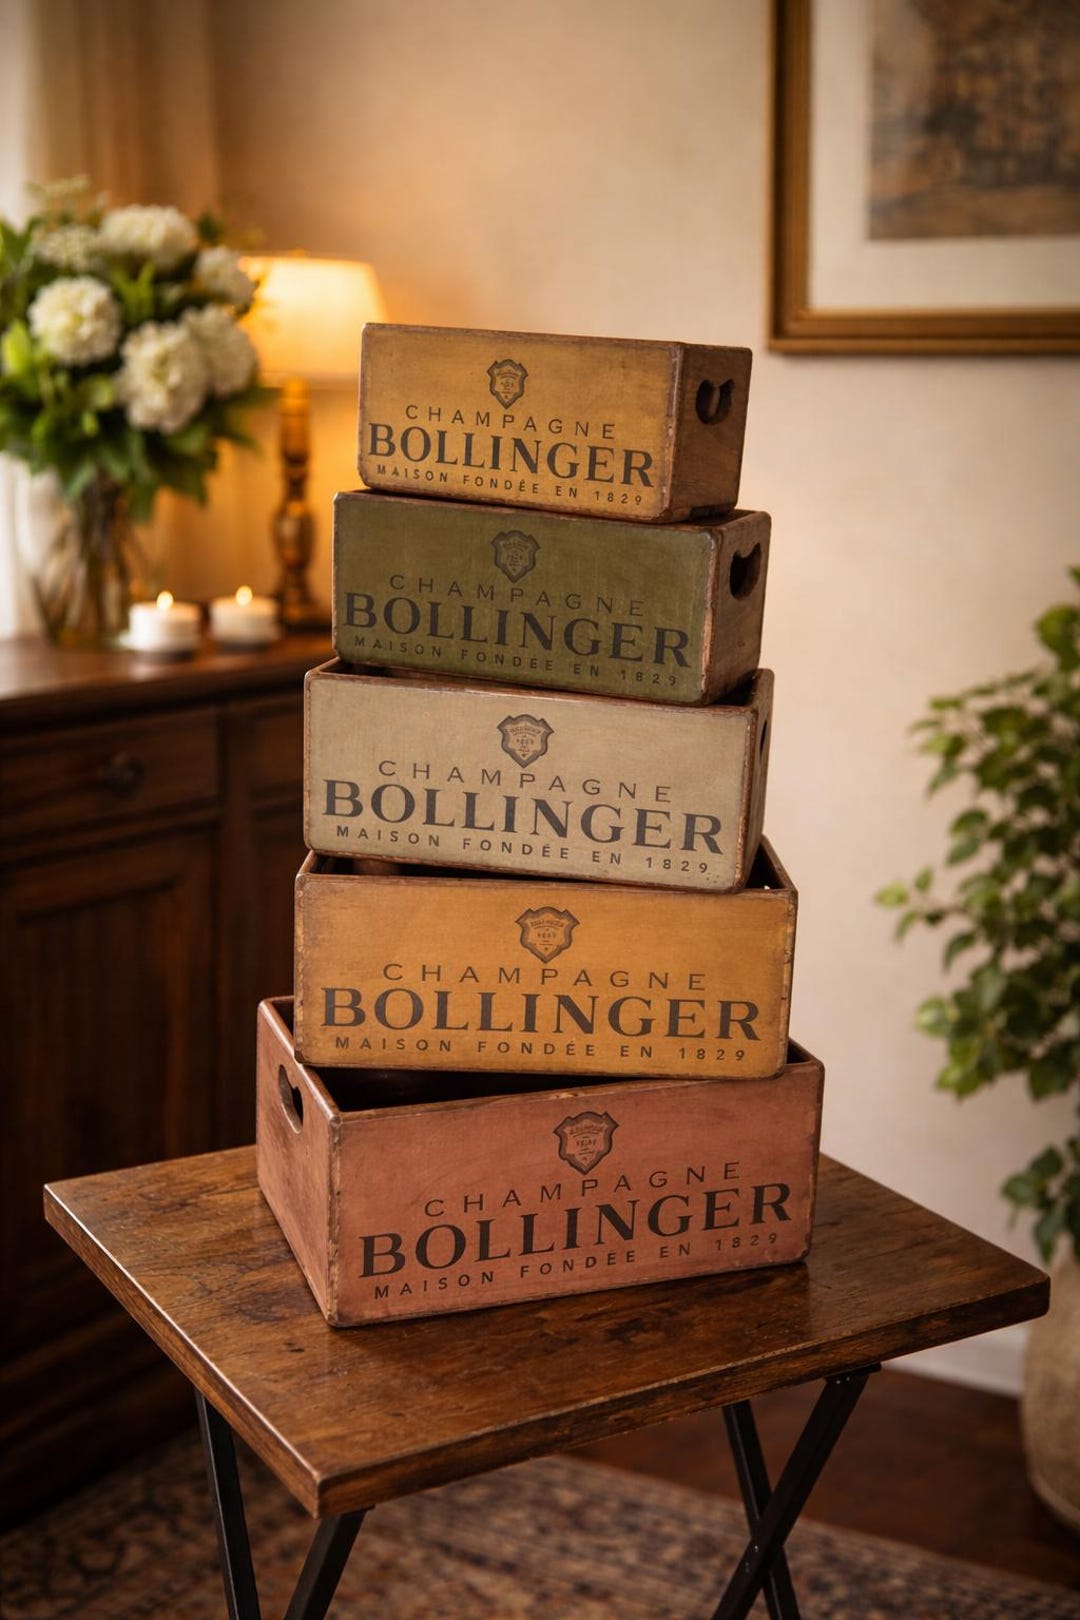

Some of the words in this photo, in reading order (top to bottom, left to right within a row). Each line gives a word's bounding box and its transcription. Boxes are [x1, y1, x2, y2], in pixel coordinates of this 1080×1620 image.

[405, 404, 616, 439] CHAMPAGNE
[368, 422, 654, 488] BOLLINGER
[377, 464, 448, 483] MAISON
[556, 485, 578, 499] EN
[595, 491, 642, 506] 1829
[389, 574, 645, 616] CHAMPAGNE
[343, 591, 692, 668] BOLLINGER
[355, 635, 442, 657] MAISON
[573, 663, 599, 677] EN
[621, 669, 677, 686] 1829
[378, 760, 672, 803] CHAMPAGNE
[322, 779, 724, 856] BOLLINGER
[337, 825, 440, 847] MAISON
[463, 838, 569, 859] FONDÉE
[592, 851, 622, 865] EN
[645, 857, 708, 874] 1829
[382, 963, 706, 991] CHAMPAGNE
[320, 986, 761, 1041] BOLLINGER
[335, 1036, 452, 1052] MAISON
[478, 1038, 596, 1057] FONDÉE
[620, 1045, 653, 1059] EN
[678, 1047, 746, 1062] 1829
[424, 1161, 741, 1218] CHAMPAGNE
[358, 1182, 792, 1279] BOLLINGER
[374, 1270, 495, 1300] MAISON
[659, 1241, 692, 1259] EN
[715, 1232, 778, 1252] 1829
